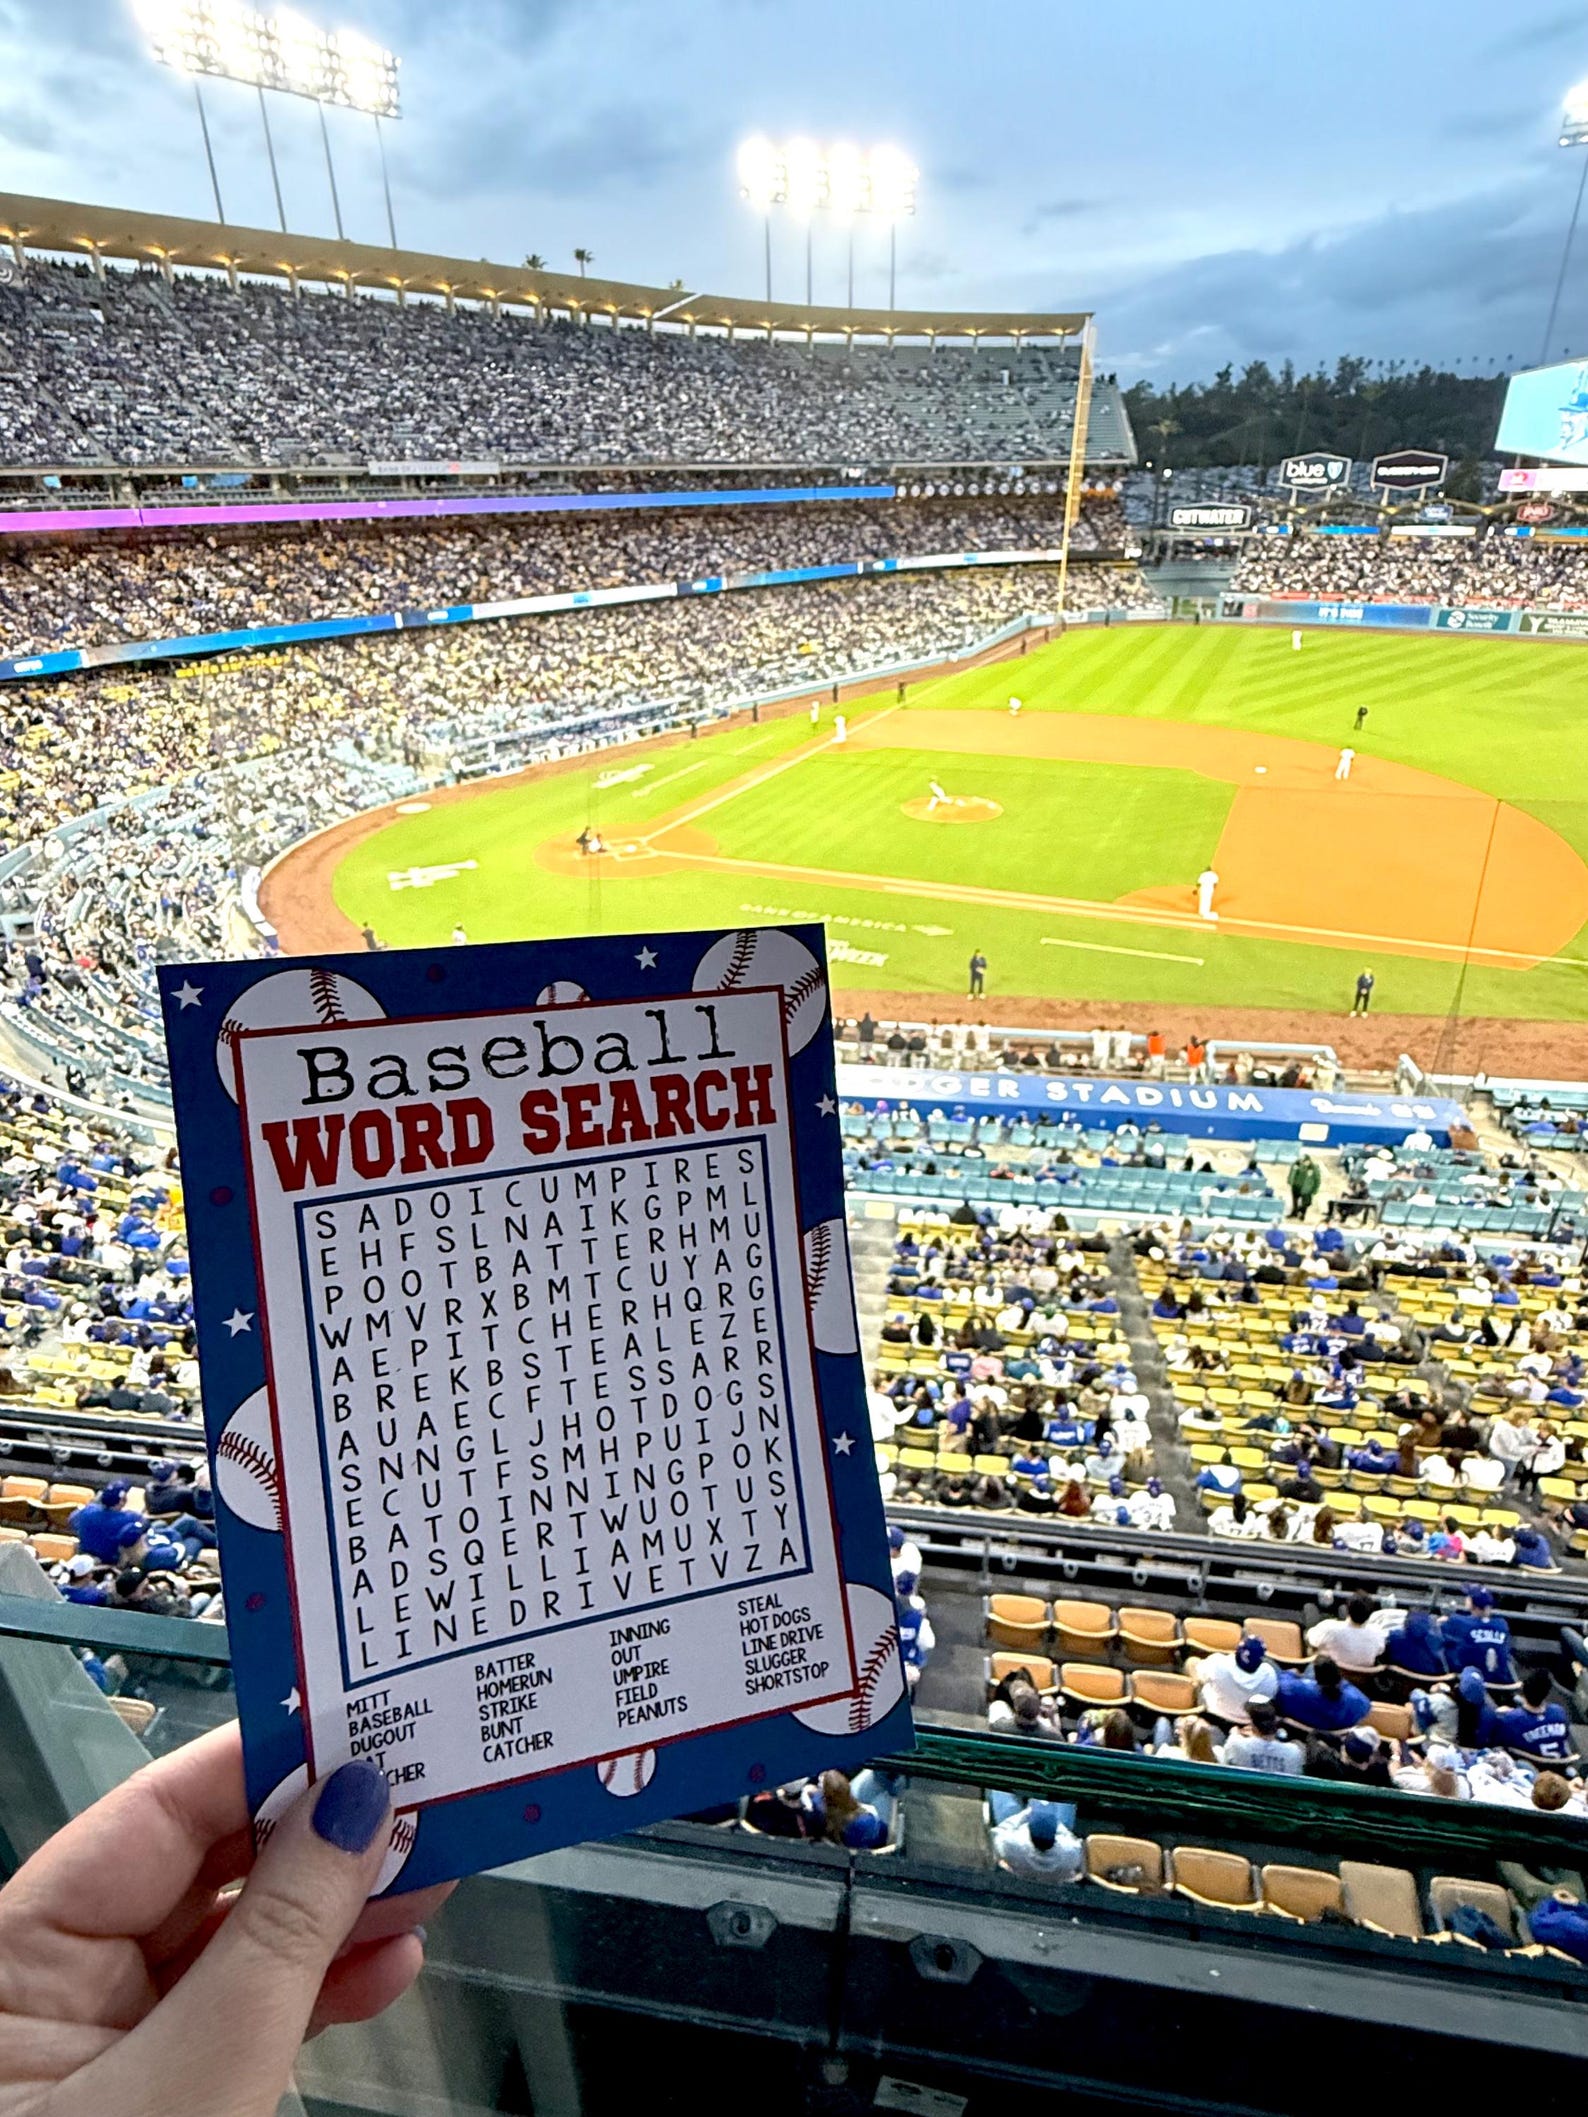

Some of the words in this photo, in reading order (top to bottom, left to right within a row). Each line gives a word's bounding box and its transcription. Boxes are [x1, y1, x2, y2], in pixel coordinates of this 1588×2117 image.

[1286, 461, 1325, 478] blue
[1172, 508, 1245, 525] CUTWATER
[297, 1005, 736, 1105] Baseball
[1046, 1081, 1264, 1113] STADIUM
[261, 1097, 494, 1192] WORD
[520, 1064, 777, 1156] SEARCH
[738, 1593, 783, 1616] STEAL
[609, 1618, 671, 1648] INNING
[740, 1615, 769, 1637] HOT
[773, 1607, 811, 1630] DOGS
[742, 1635, 777, 1657] LINE
[780, 1623, 824, 1647] DRIVE
[475, 1652, 536, 1682] BATTER
[611, 1644, 642, 1667] OUT
[744, 1648, 808, 1676] SLUGGER
[476, 1667, 553, 1702] HOMERUN
[613, 1658, 670, 1687] UMPIRE
[745, 1661, 829, 1696] SHORTSTOP
[346, 1689, 391, 1719] MITT
[479, 1691, 538, 1722] STRIKE
[616, 1682, 658, 1708] FIELD
[349, 1698, 433, 1738] BASEBALL
[617, 1696, 688, 1729] PEANUTS
[350, 1721, 417, 1758] DUGOUT
[481, 1716, 524, 1743] BUNT
[483, 1730, 554, 1764] CATCHER
[386, 1762, 426, 1787] CHER
